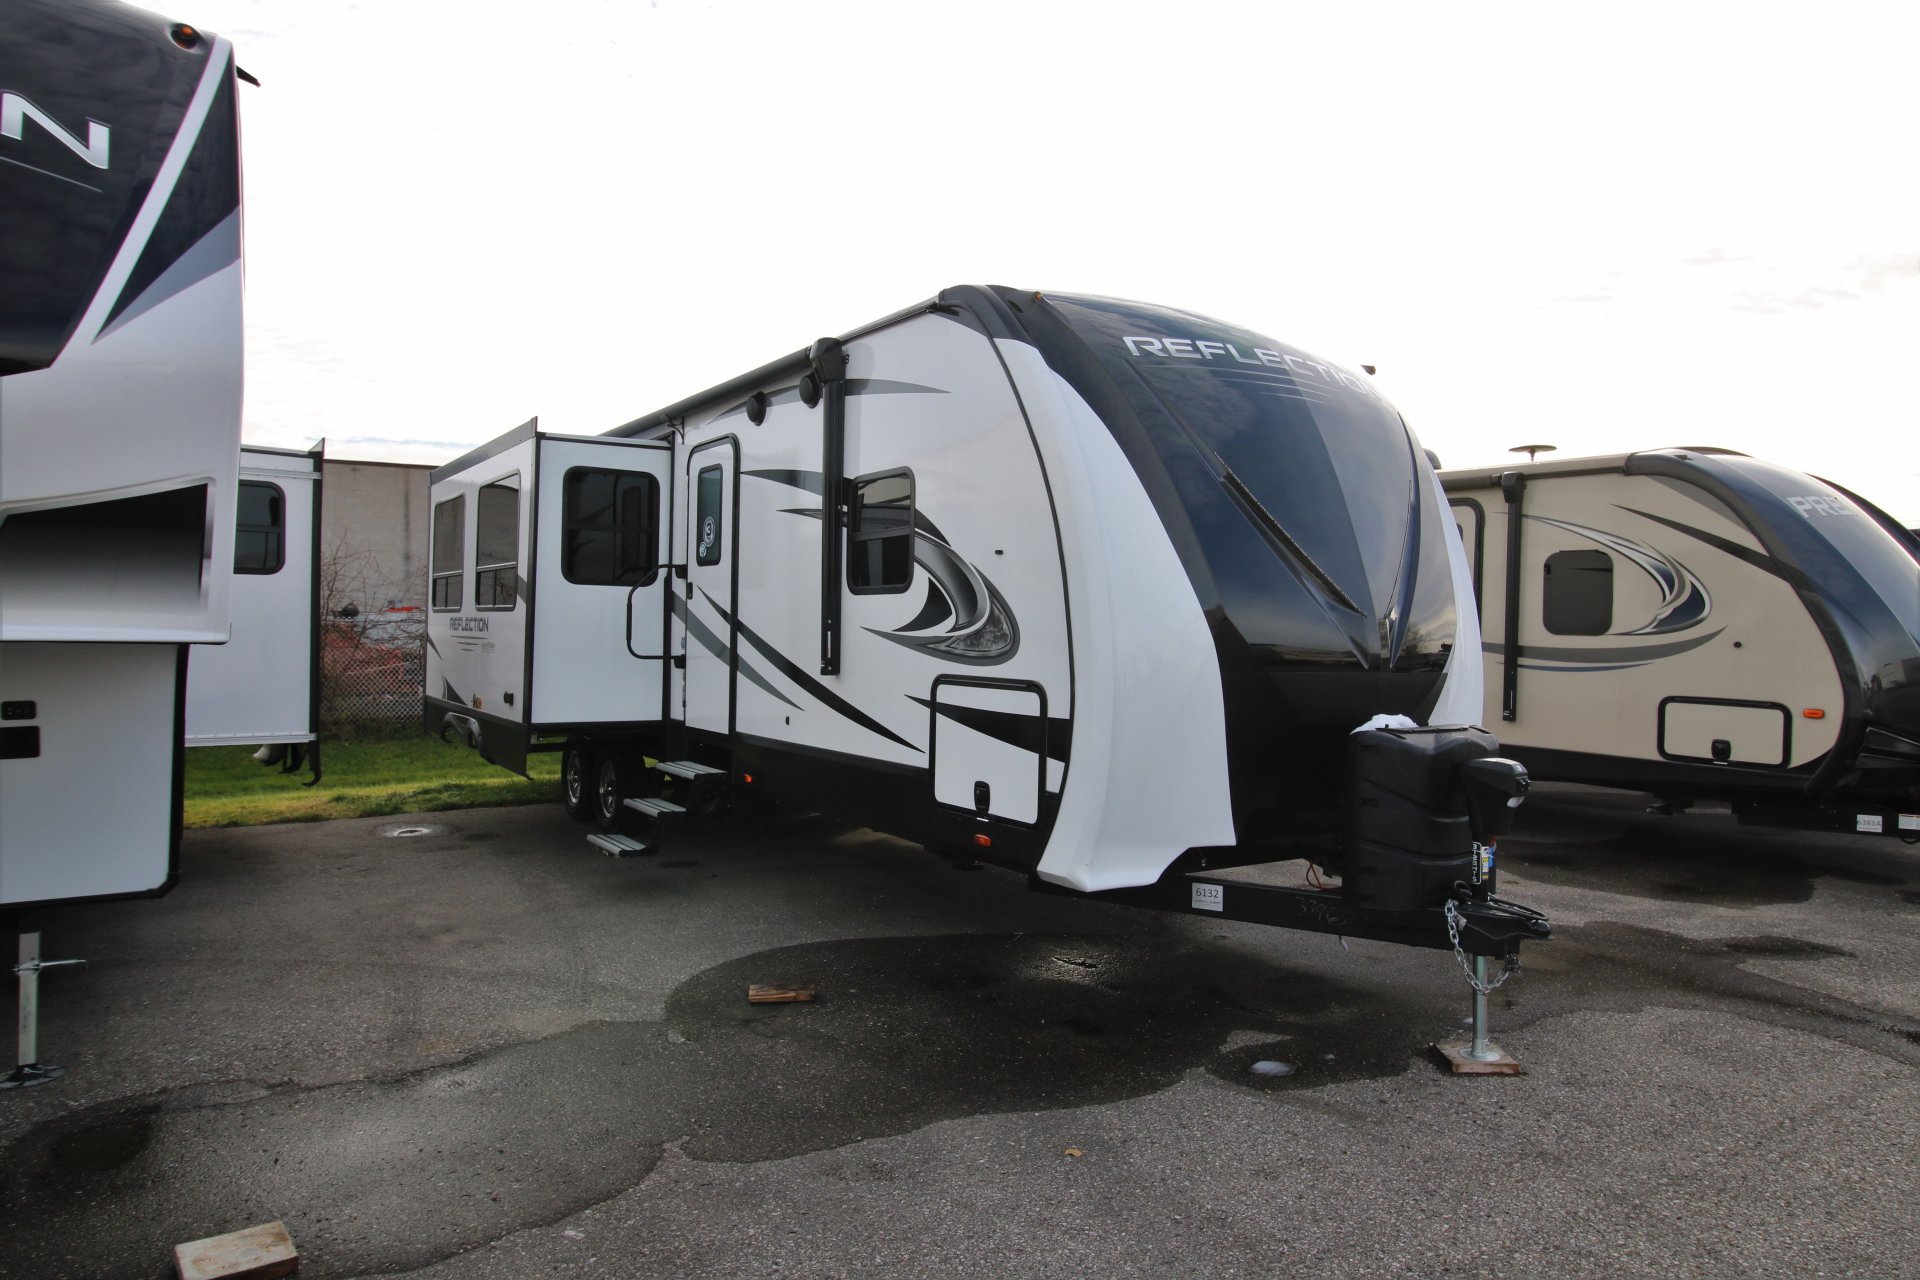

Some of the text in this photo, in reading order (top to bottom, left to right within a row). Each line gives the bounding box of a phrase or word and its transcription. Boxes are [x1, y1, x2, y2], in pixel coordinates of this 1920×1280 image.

[1122, 336, 1384, 399] REFLECTION
[449, 616, 489, 632] REFLECTION
[1195, 887, 1219, 899] 6132
